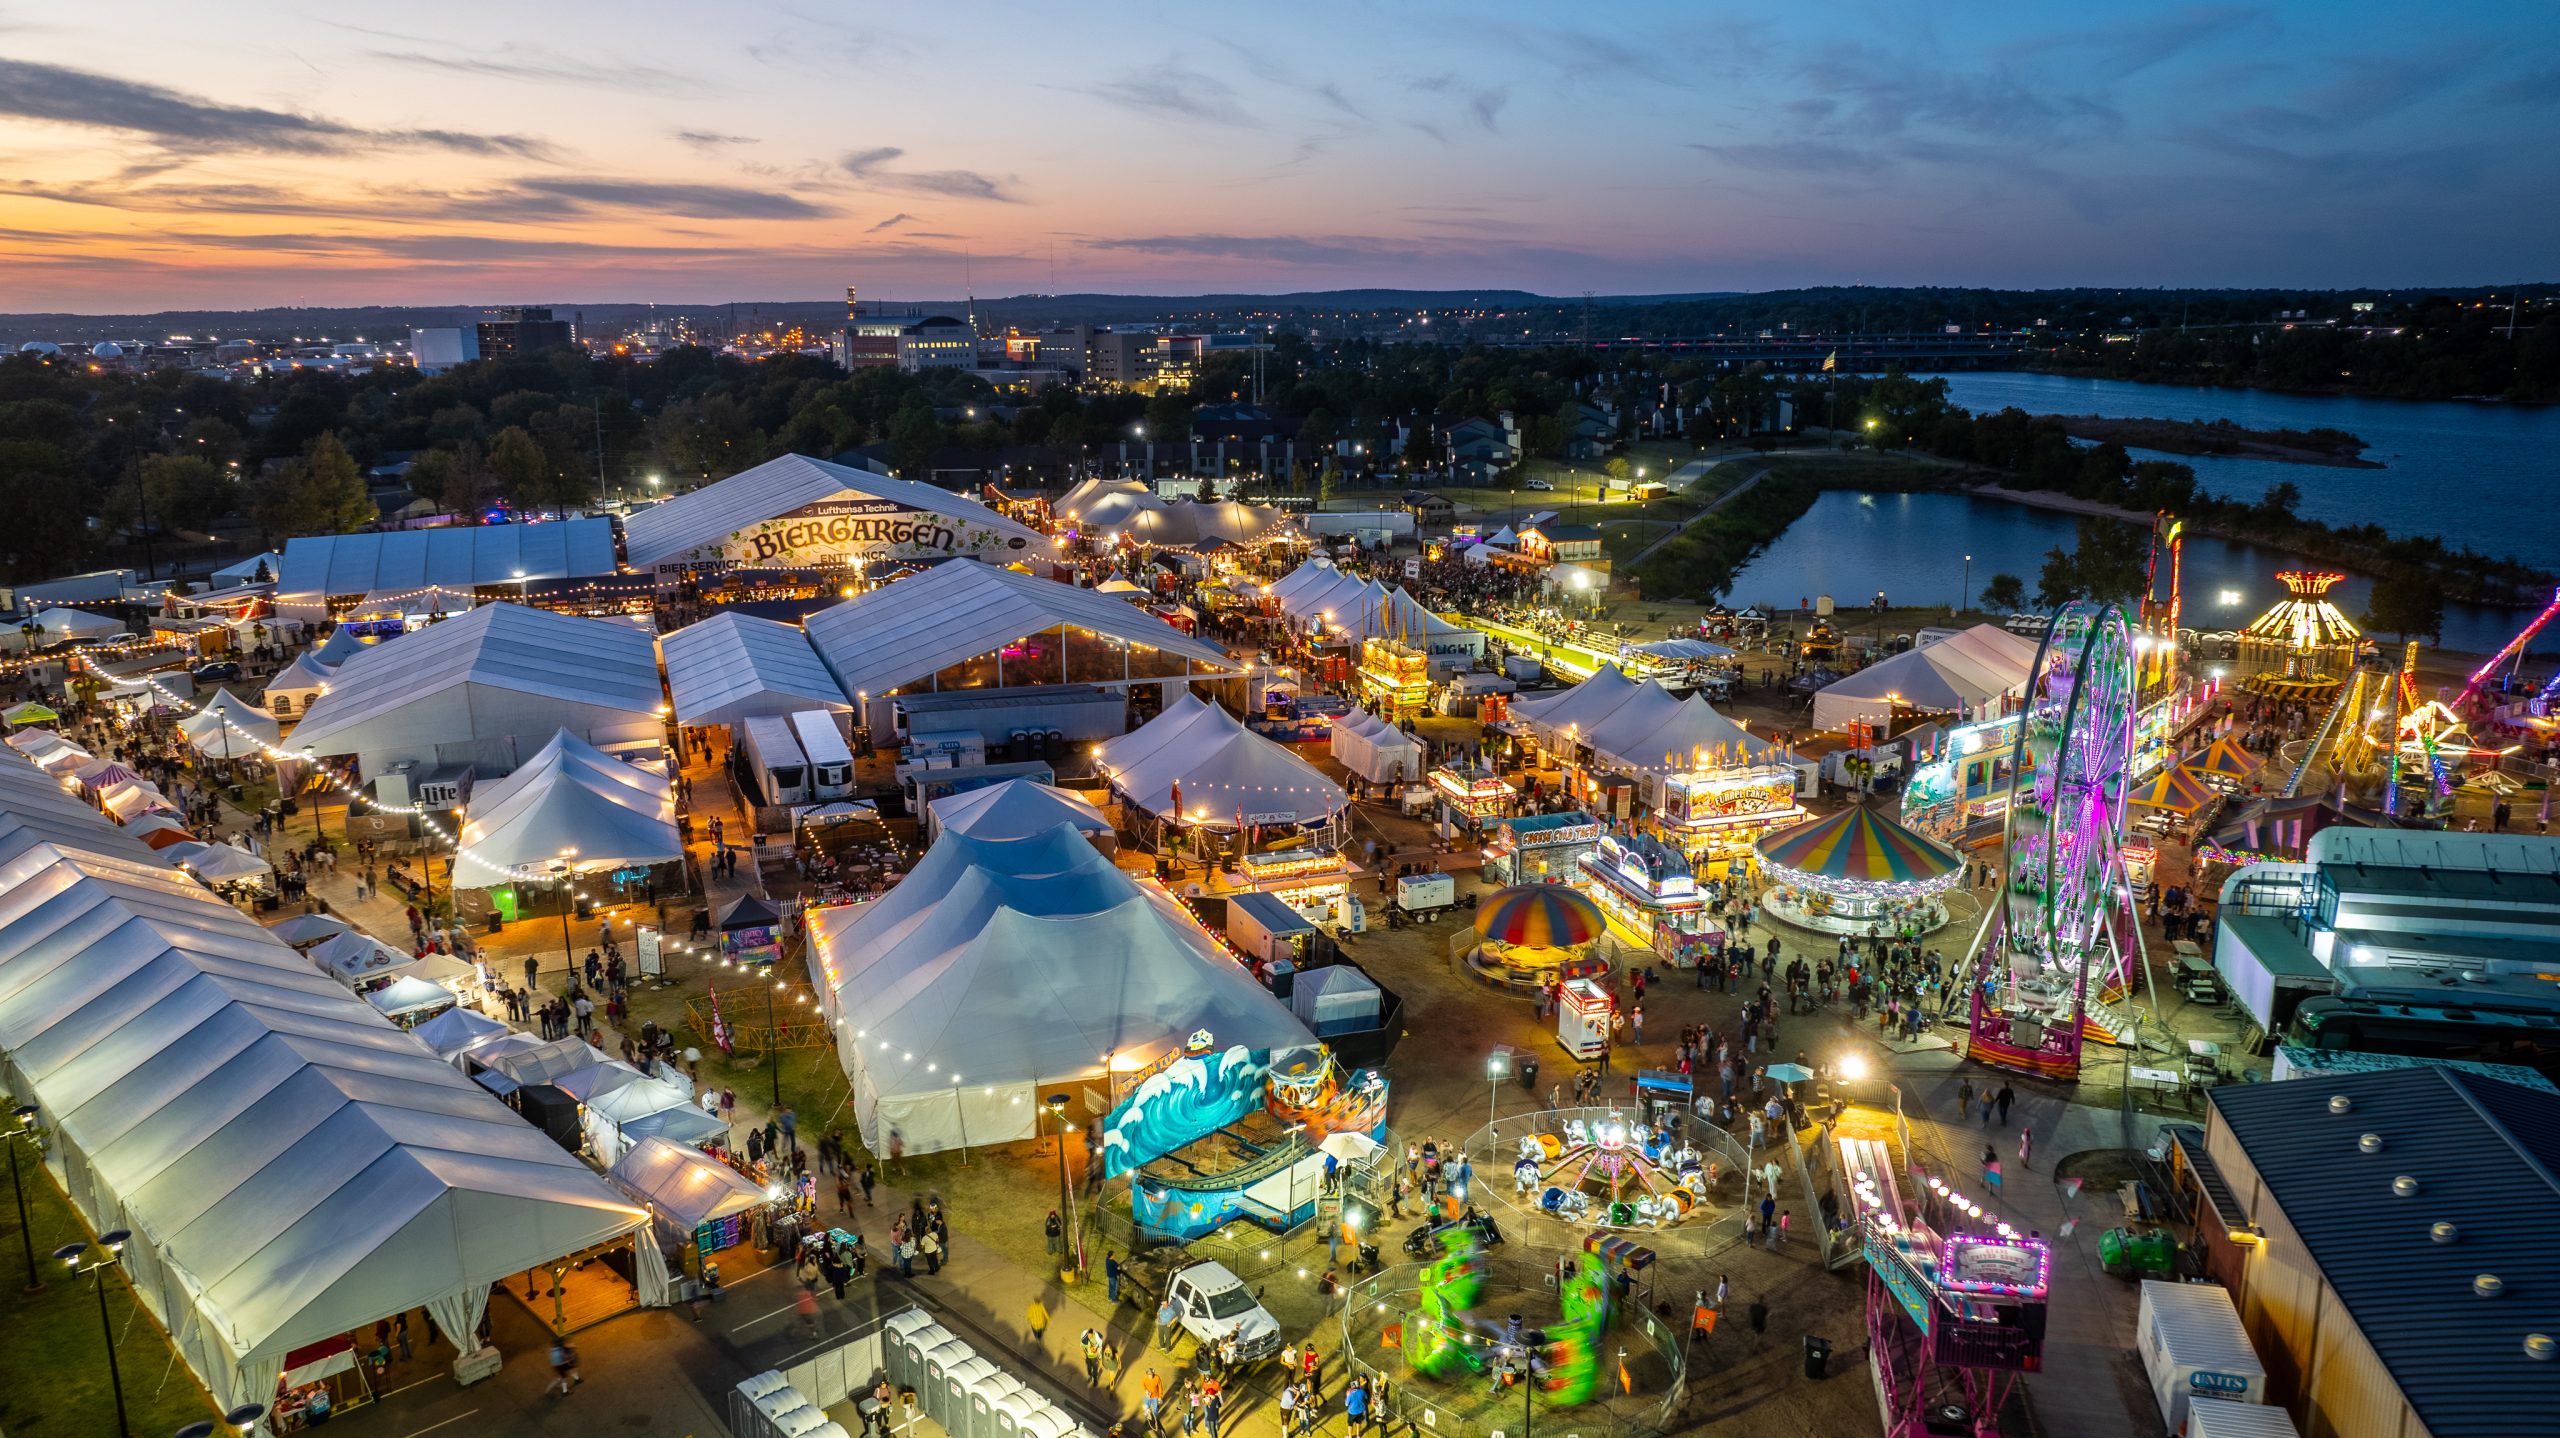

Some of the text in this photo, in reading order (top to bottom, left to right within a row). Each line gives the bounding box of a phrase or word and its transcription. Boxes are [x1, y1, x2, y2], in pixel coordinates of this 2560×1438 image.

[817, 503, 898, 515] Lufthansa Technik
[750, 514, 954, 562] BIERGARTEN
[659, 559, 743, 574] BIER SERVICE
[1436, 643, 1475, 657] LIGHT
[422, 786, 457, 805] Lite
[1575, 823, 1599, 841] TACOS
[2130, 834, 2149, 848] FOUND
[740, 928, 764, 938] Fancy
[2194, 1373, 2244, 1388] UNITS
